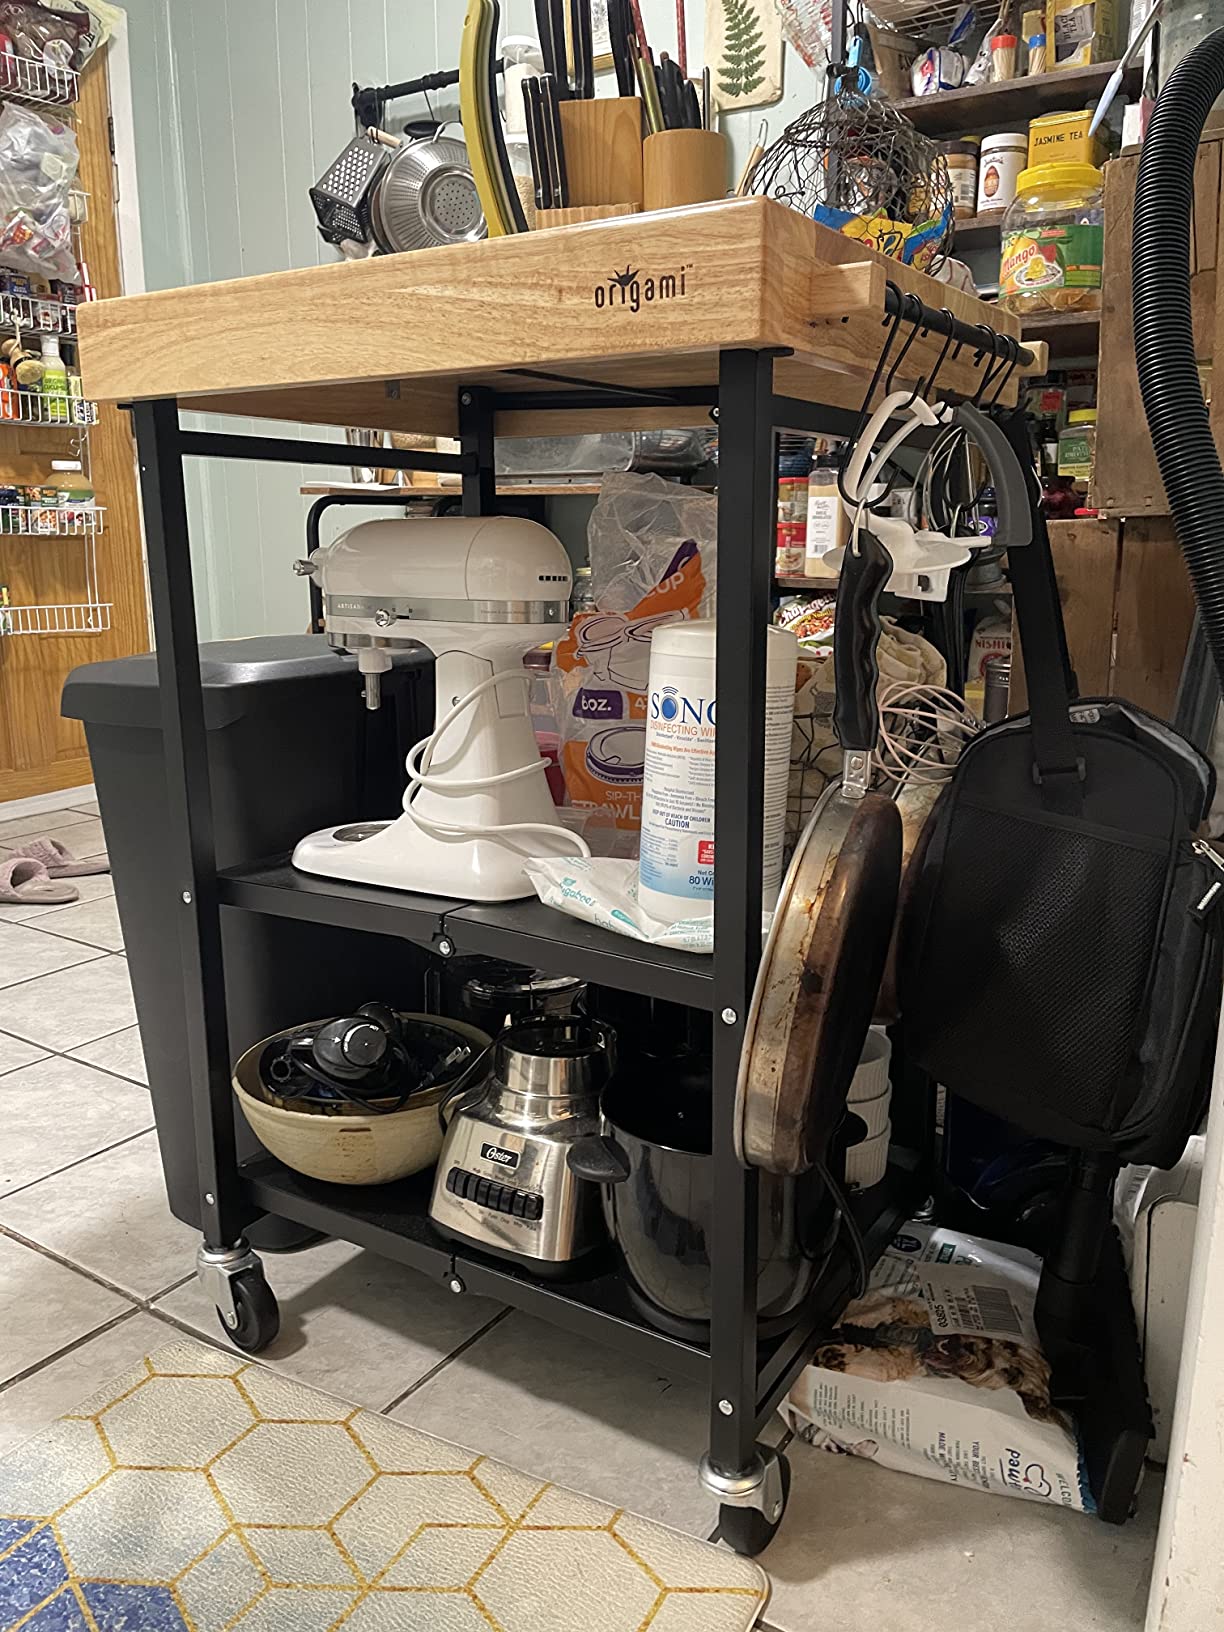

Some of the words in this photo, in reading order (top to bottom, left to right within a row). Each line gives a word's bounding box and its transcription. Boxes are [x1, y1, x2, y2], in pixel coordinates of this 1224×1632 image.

[1033, 134, 1065, 147] JASMINE
[1069, 130, 1083, 140] TEA
[594, 265, 685, 313] origami
[664, 817, 690, 828] CAUTION
[689, 815, 711, 823] CHILDREN
[688, 875, 701, 885] 80
[486, 1147, 513, 1164] Oster
[938, 1431, 946, 1450] MADE
